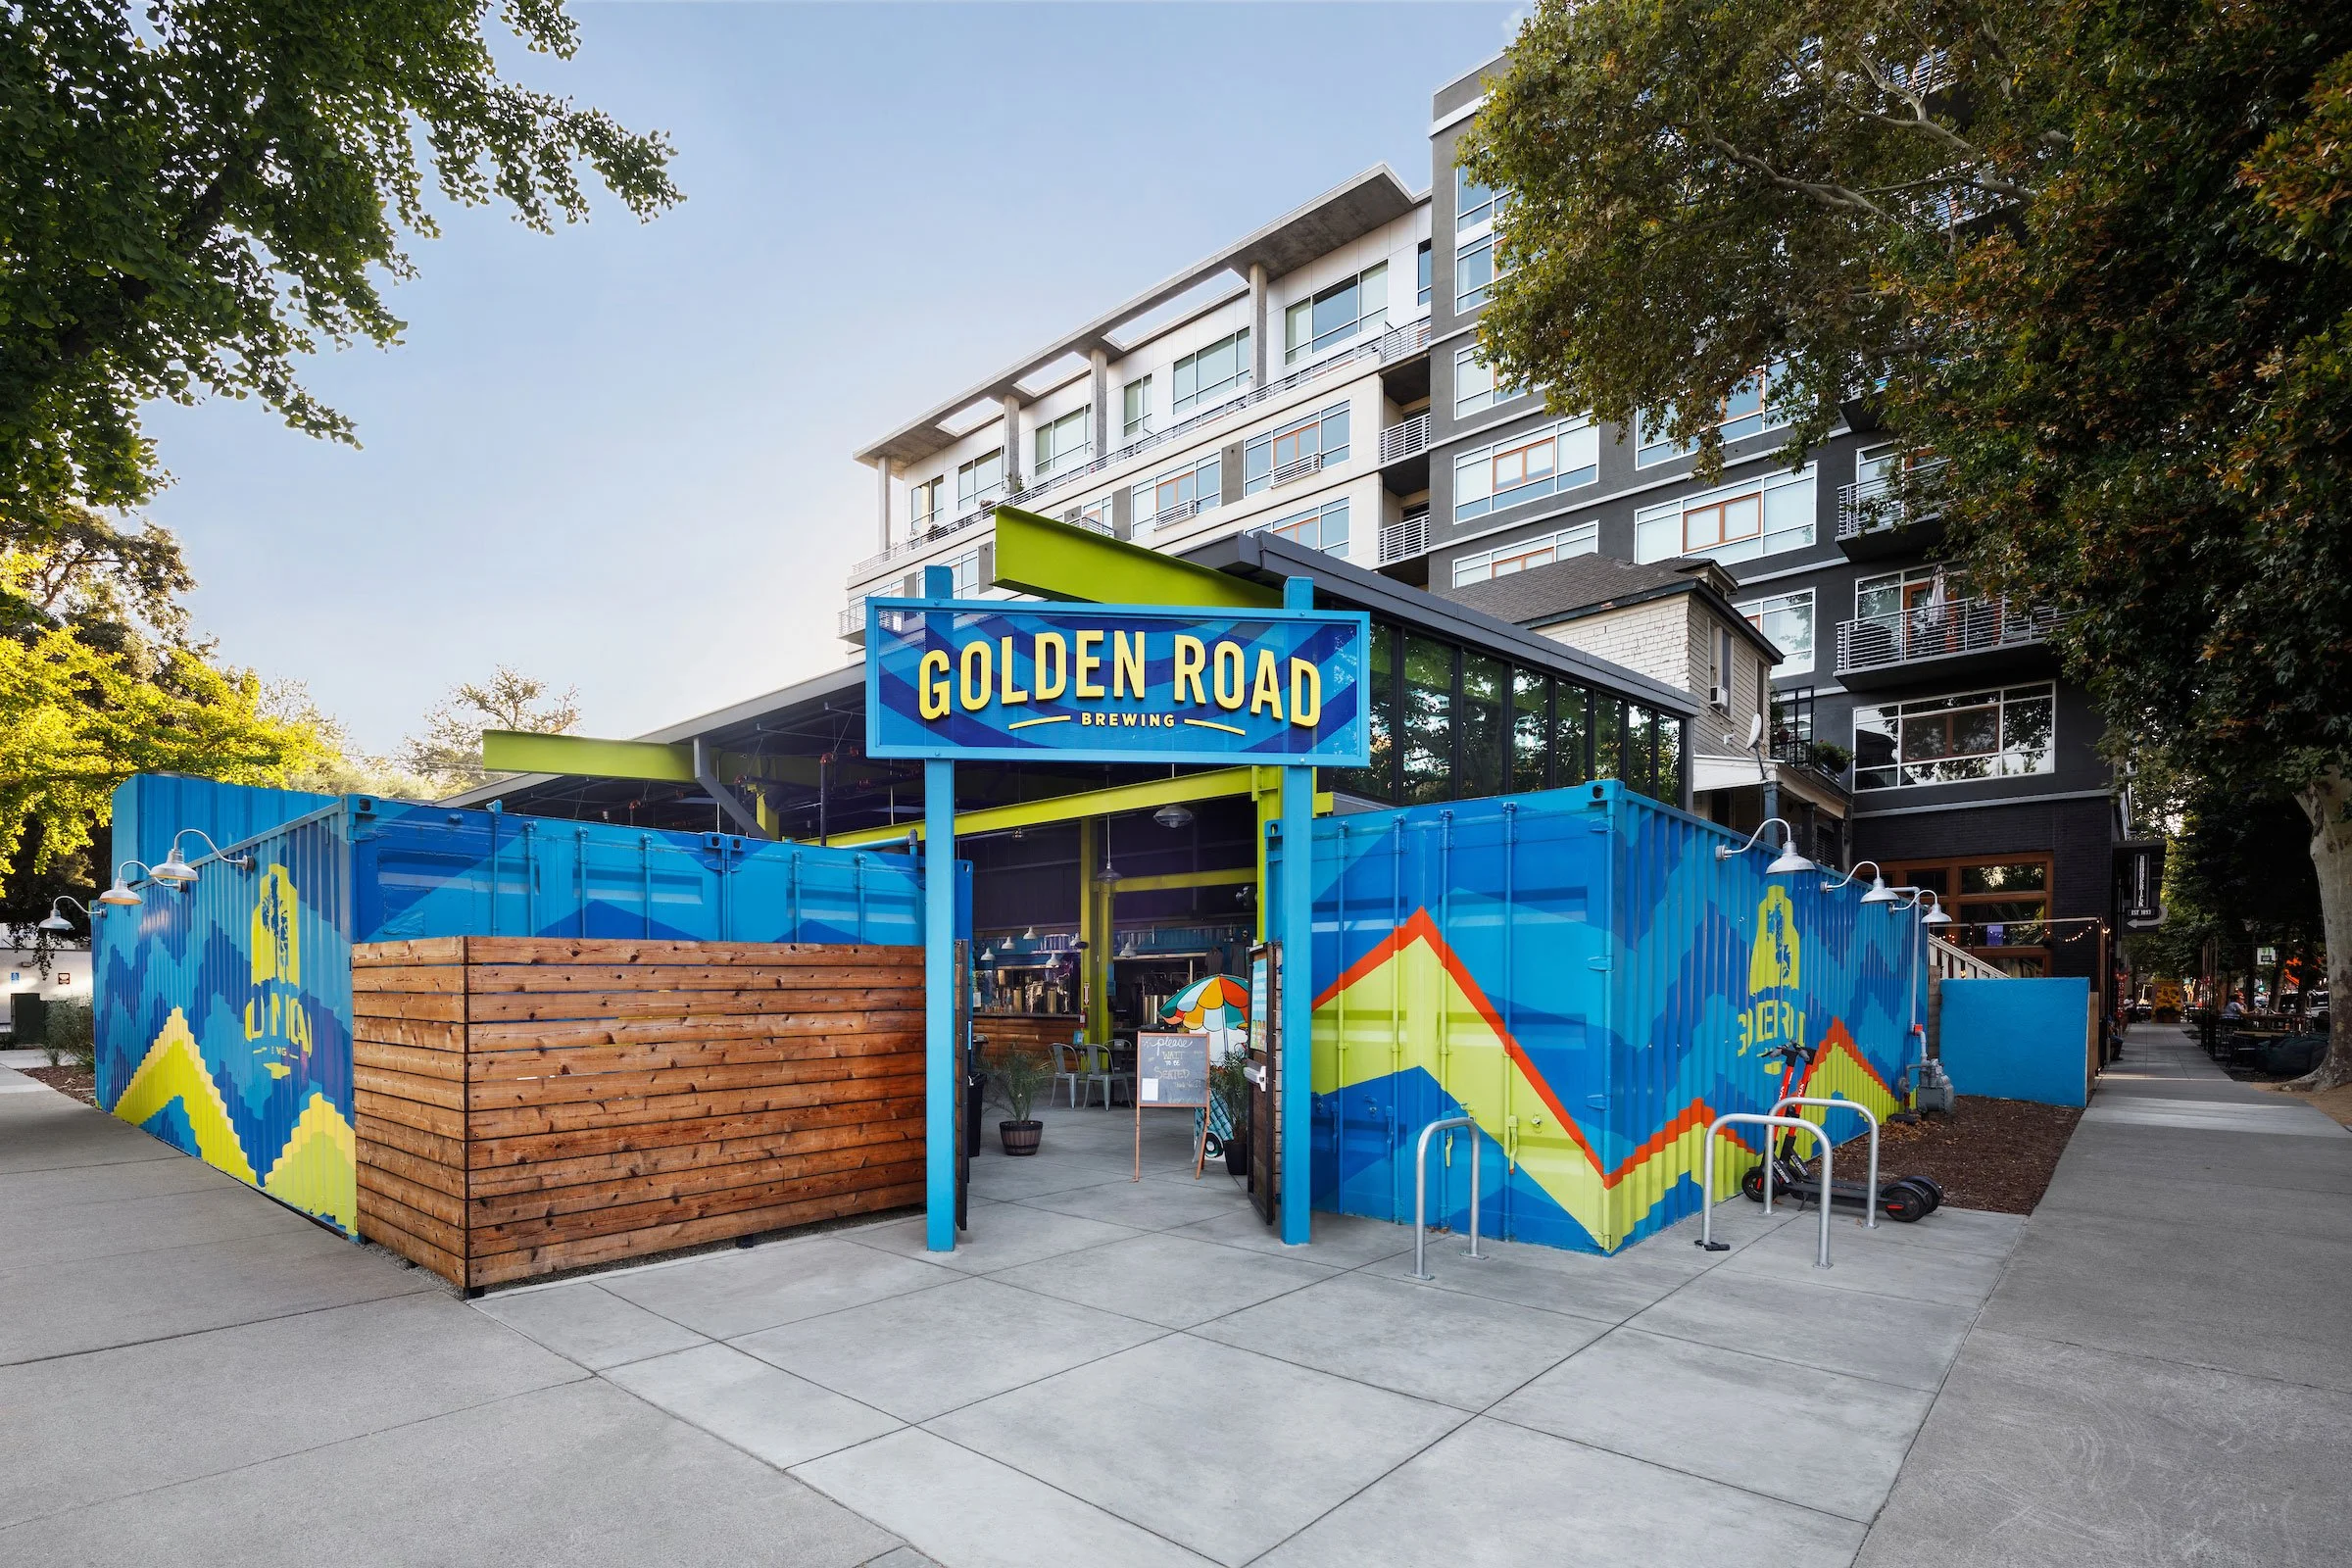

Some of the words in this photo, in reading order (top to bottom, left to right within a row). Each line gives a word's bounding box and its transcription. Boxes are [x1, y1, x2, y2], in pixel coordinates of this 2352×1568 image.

[918, 628, 1146, 721] GOLDEN
[1173, 633, 1321, 728] ROAD
[1081, 711, 1175, 728] BREWING
